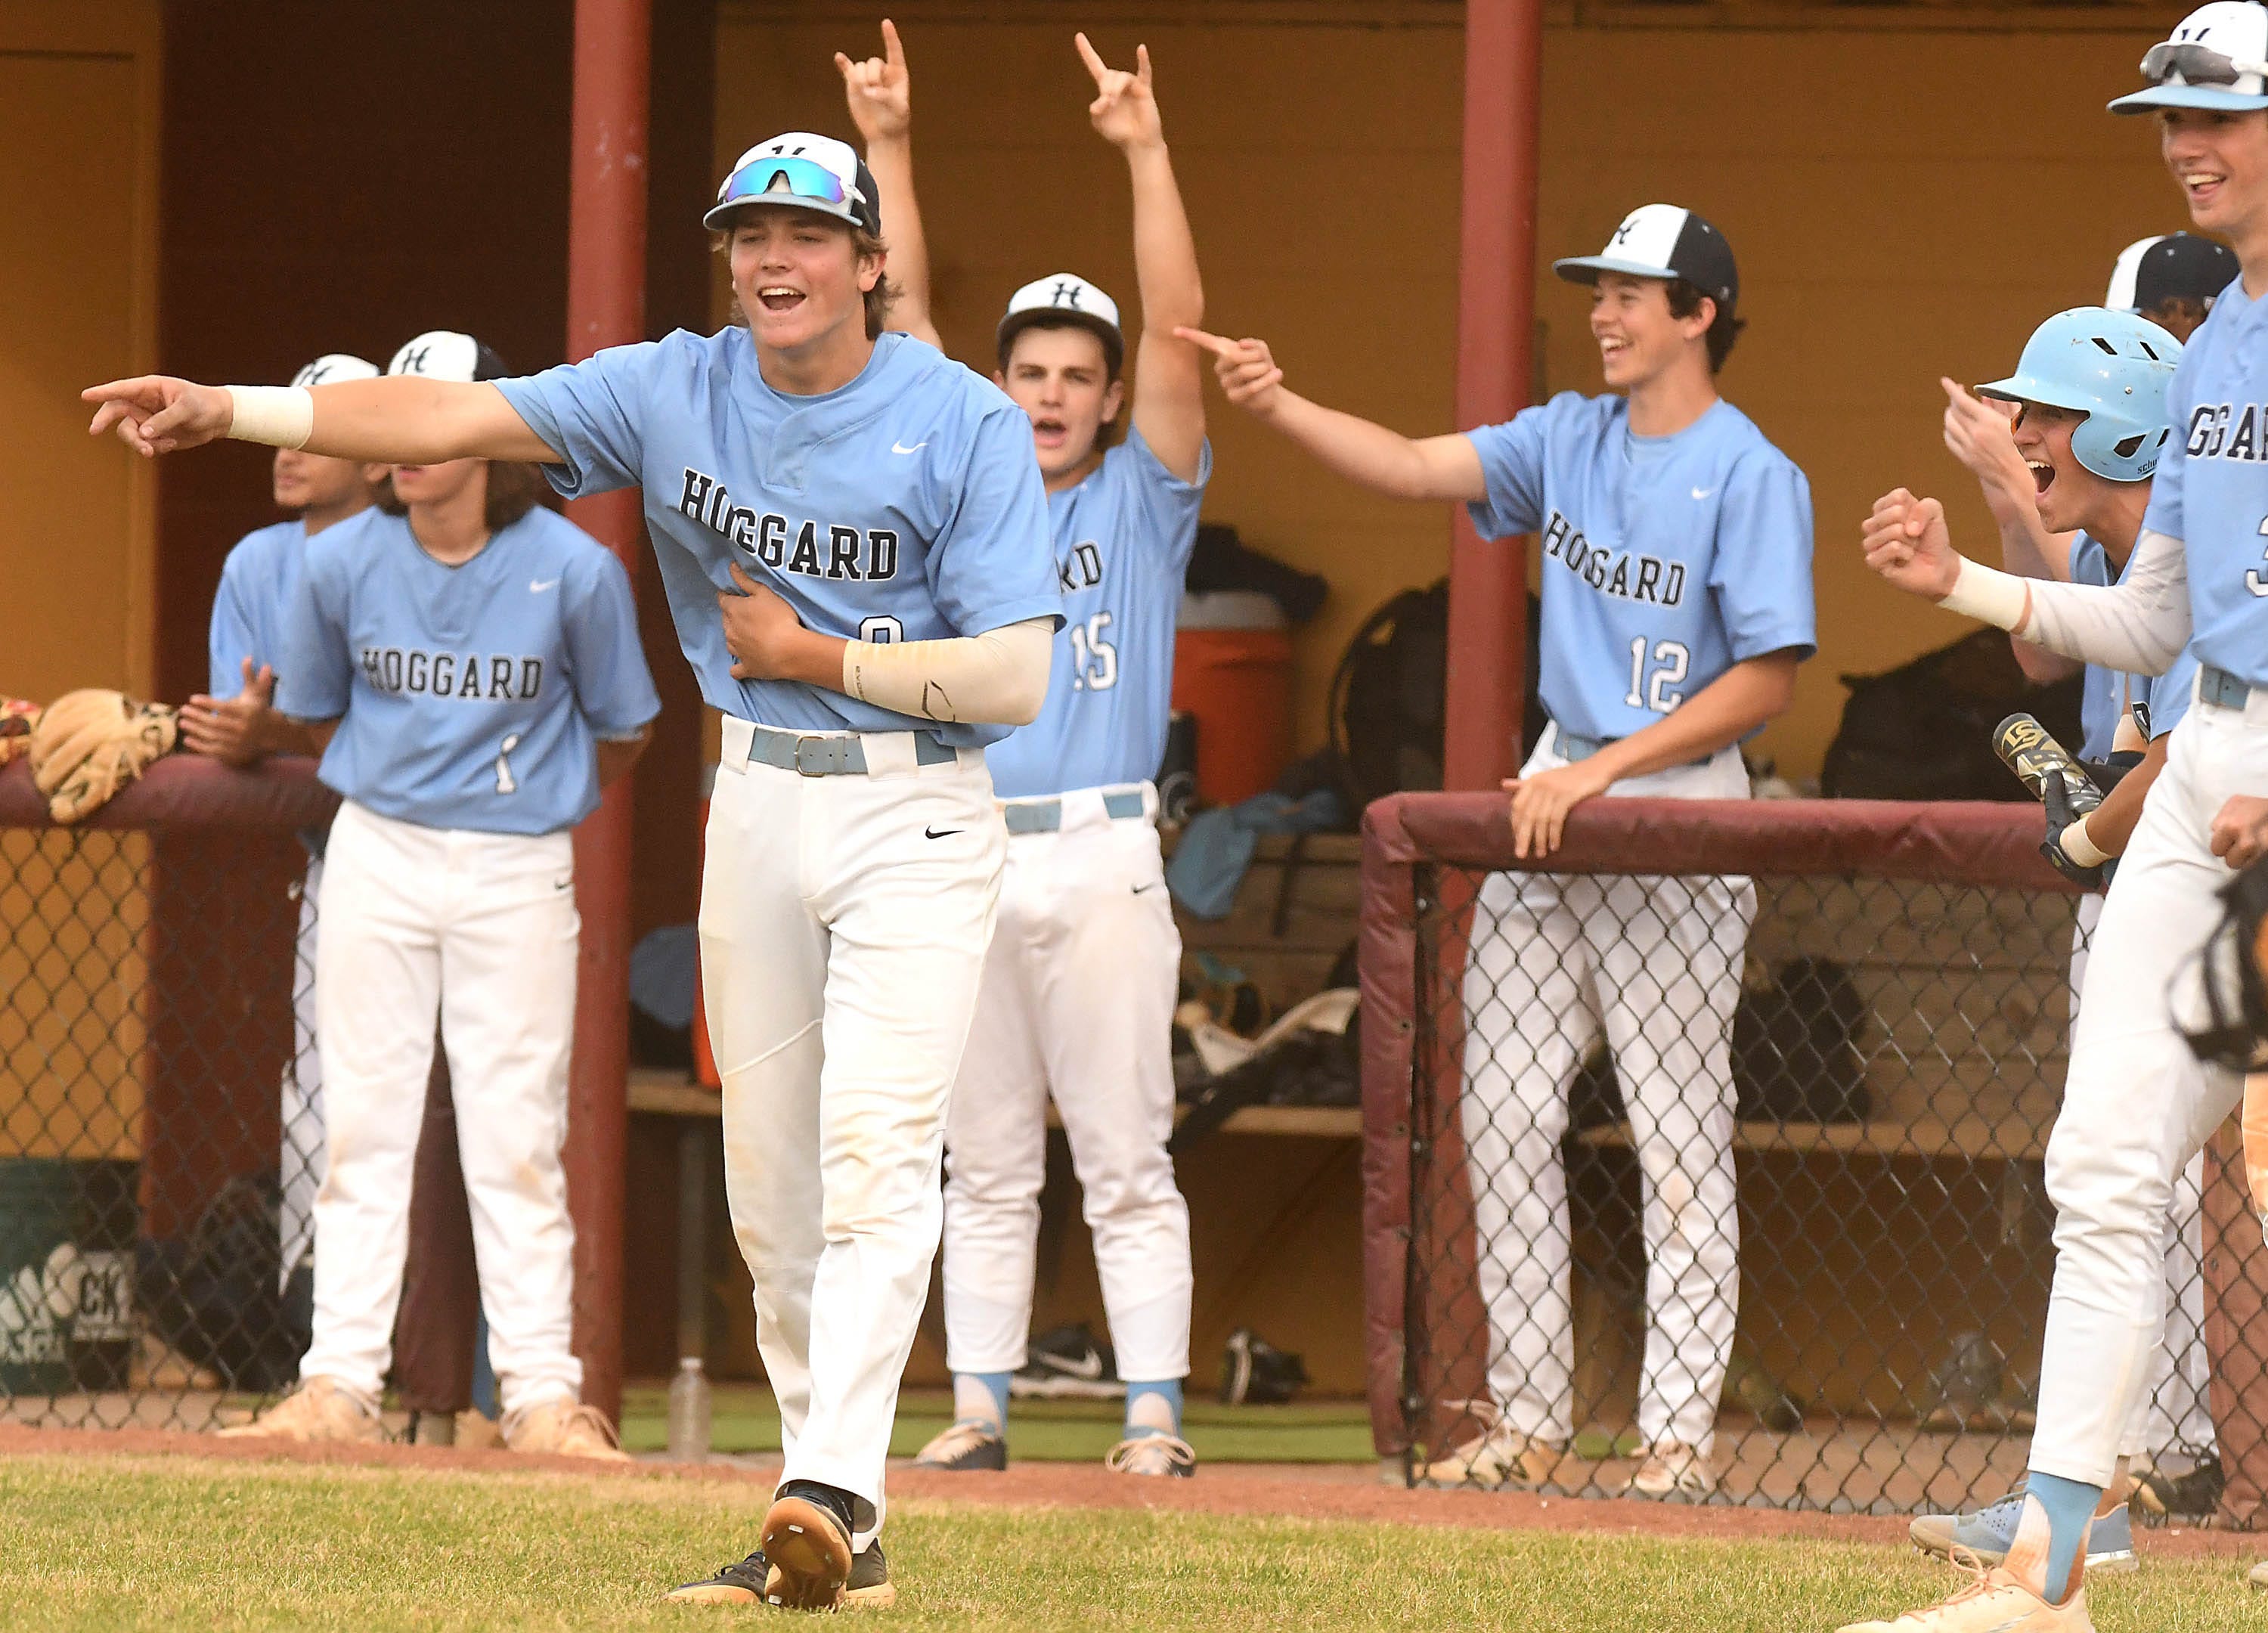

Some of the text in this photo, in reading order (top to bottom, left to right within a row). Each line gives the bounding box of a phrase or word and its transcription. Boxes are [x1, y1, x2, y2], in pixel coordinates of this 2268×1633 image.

[1544, 509, 1687, 609] HOGARD
[1070, 611, 1118, 691] 15
[1624, 635, 1690, 716] 12
